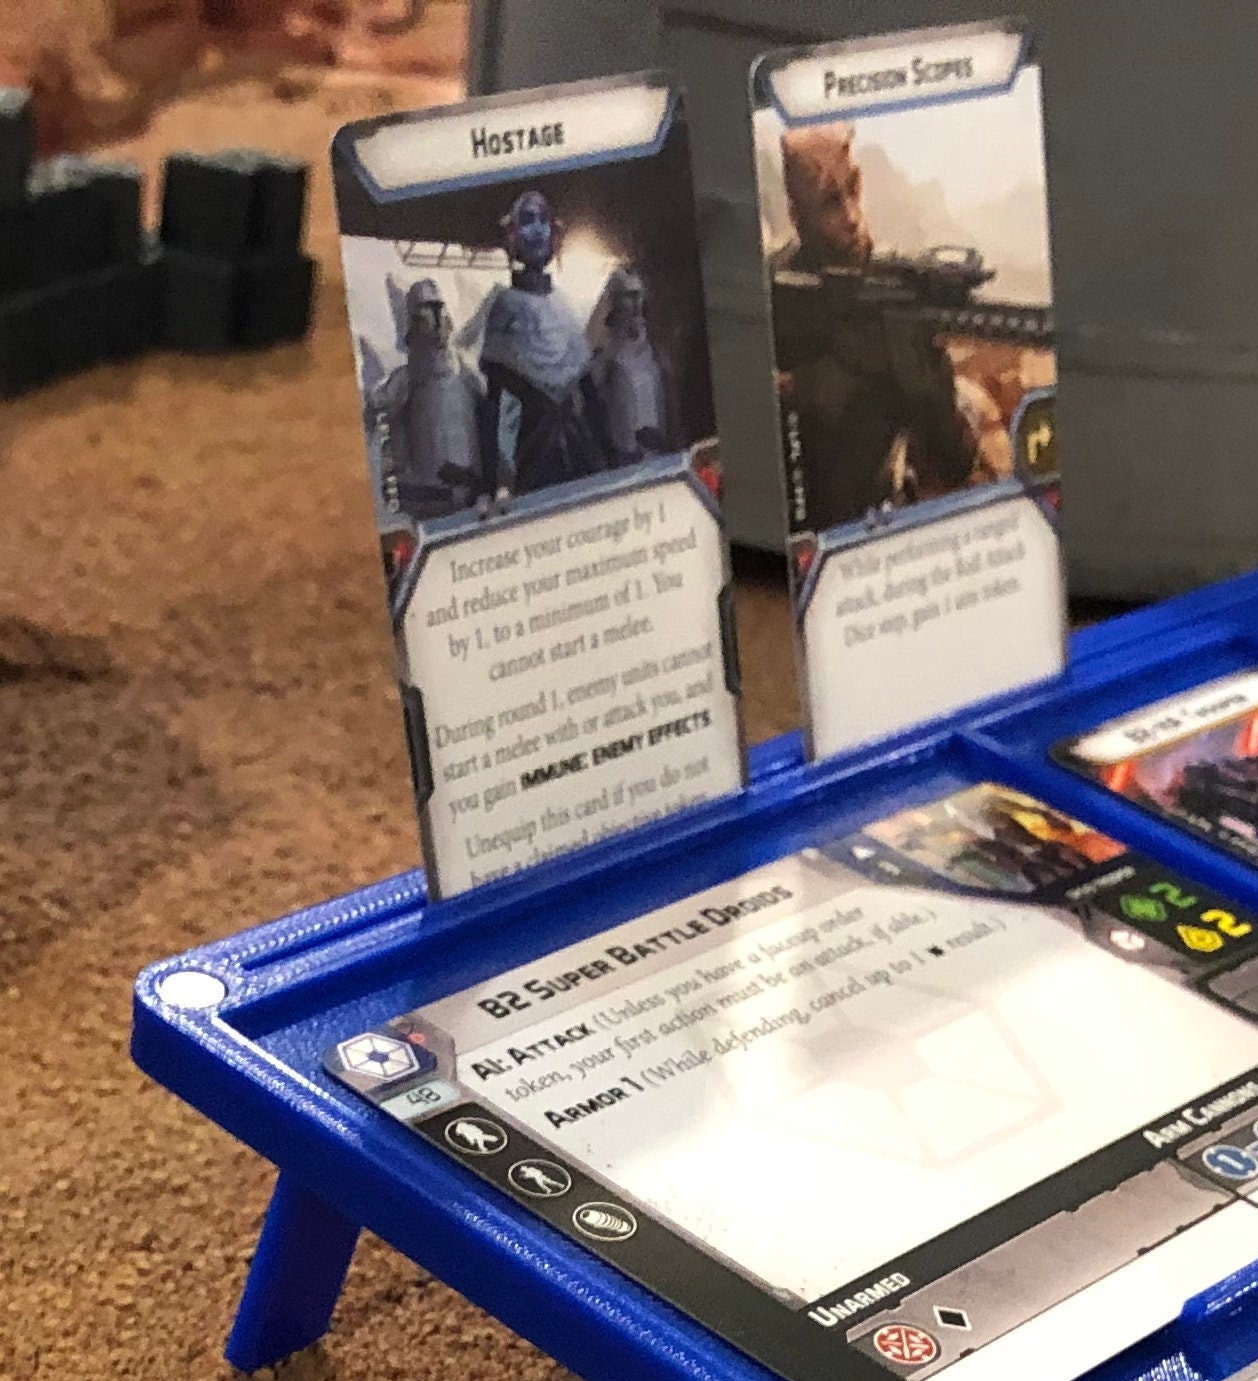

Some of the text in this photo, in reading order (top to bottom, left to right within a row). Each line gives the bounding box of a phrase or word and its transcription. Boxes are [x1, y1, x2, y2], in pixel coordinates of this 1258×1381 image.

[427, 527, 697, 627] and reduce your maximum speed
[450, 550, 518, 583] Increase
[524, 536, 561, 568] your
[567, 518, 629, 546] courage
[633, 506, 650, 533] by
[449, 633, 470, 661] by
[493, 622, 511, 643] to
[516, 621, 525, 637] a
[528, 594, 610, 633] minimum
[614, 580, 630, 606] of
[489, 649, 545, 681] cannot
[550, 635, 585, 662] start
[590, 633, 599, 649] a
[435, 716, 496, 749] During
[498, 691, 546, 726] round
[566, 674, 617, 705] enemy
[443, 756, 478, 782] start
[482, 754, 492, 768] a
[495, 735, 541, 766] melee
[545, 717, 579, 744] with
[582, 716, 599, 734] or
[449, 794, 479, 823] you
[483, 781, 516, 812] gain
[592, 734, 644, 766] ENEMY
[465, 821, 537, 858] Unequip
[541, 808, 569, 831] this
[573, 789, 608, 819] card
[1149, 882, 1197, 908] 2
[1200, 909, 1251, 937] 2
[477, 885, 794, 1019] B2 SUPER BATTLE DROIDS
[471, 1057, 512, 1081] AI:
[507, 1023, 597, 1065] ATTACK
[592, 994, 666, 1031] (Unless
[666, 982, 702, 1006] you
[696, 957, 746, 987] have
[505, 1070, 573, 1102] token,
[570, 1046, 616, 1079] your
[613, 1028, 657, 1059] first
[659, 1002, 718, 1037] action
[717, 979, 764, 1010] must
[758, 971, 787, 989] be
[789, 959, 816, 978] an
[544, 1087, 630, 1129] ARMOR
[620, 1076, 645, 1092] 1
[640, 1048, 713, 1088] (While
[713, 1007, 813, 1056] defending,
[809, 976, 867, 1013] cancel
[864, 968, 896, 986] up
[889, 959, 913, 975] to
[406, 1084, 442, 1107] 48
[1142, 1119, 1193, 1149] ARM
[807, 1272, 911, 1327] UNARMED
